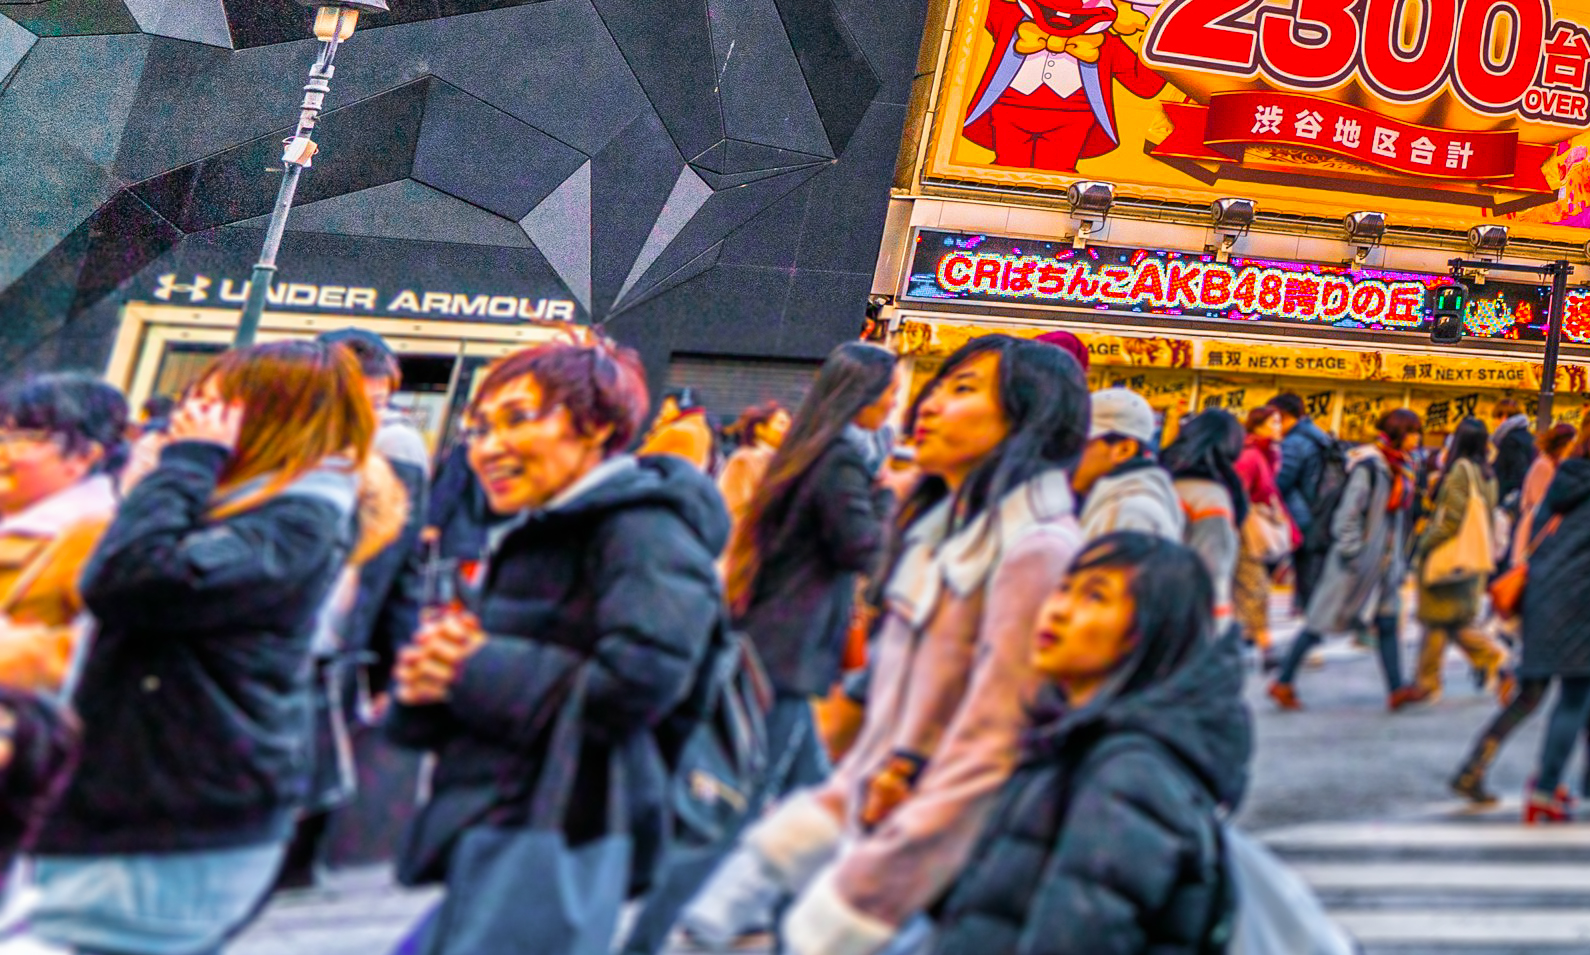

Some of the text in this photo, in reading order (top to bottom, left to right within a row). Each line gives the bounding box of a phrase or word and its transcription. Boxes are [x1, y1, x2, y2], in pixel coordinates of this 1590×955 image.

[1525, 90, 1588, 120] OVER
[1252, 102, 1475, 172] 渋谷地区合計
[219, 279, 576, 322] UNDER ARMOUR
[1088, 342, 1121, 357] AGE
[1207, 349, 1347, 371] 無双 NEXT STAGE
[1402, 363, 1525, 382] 無双 NEXT STAGE
